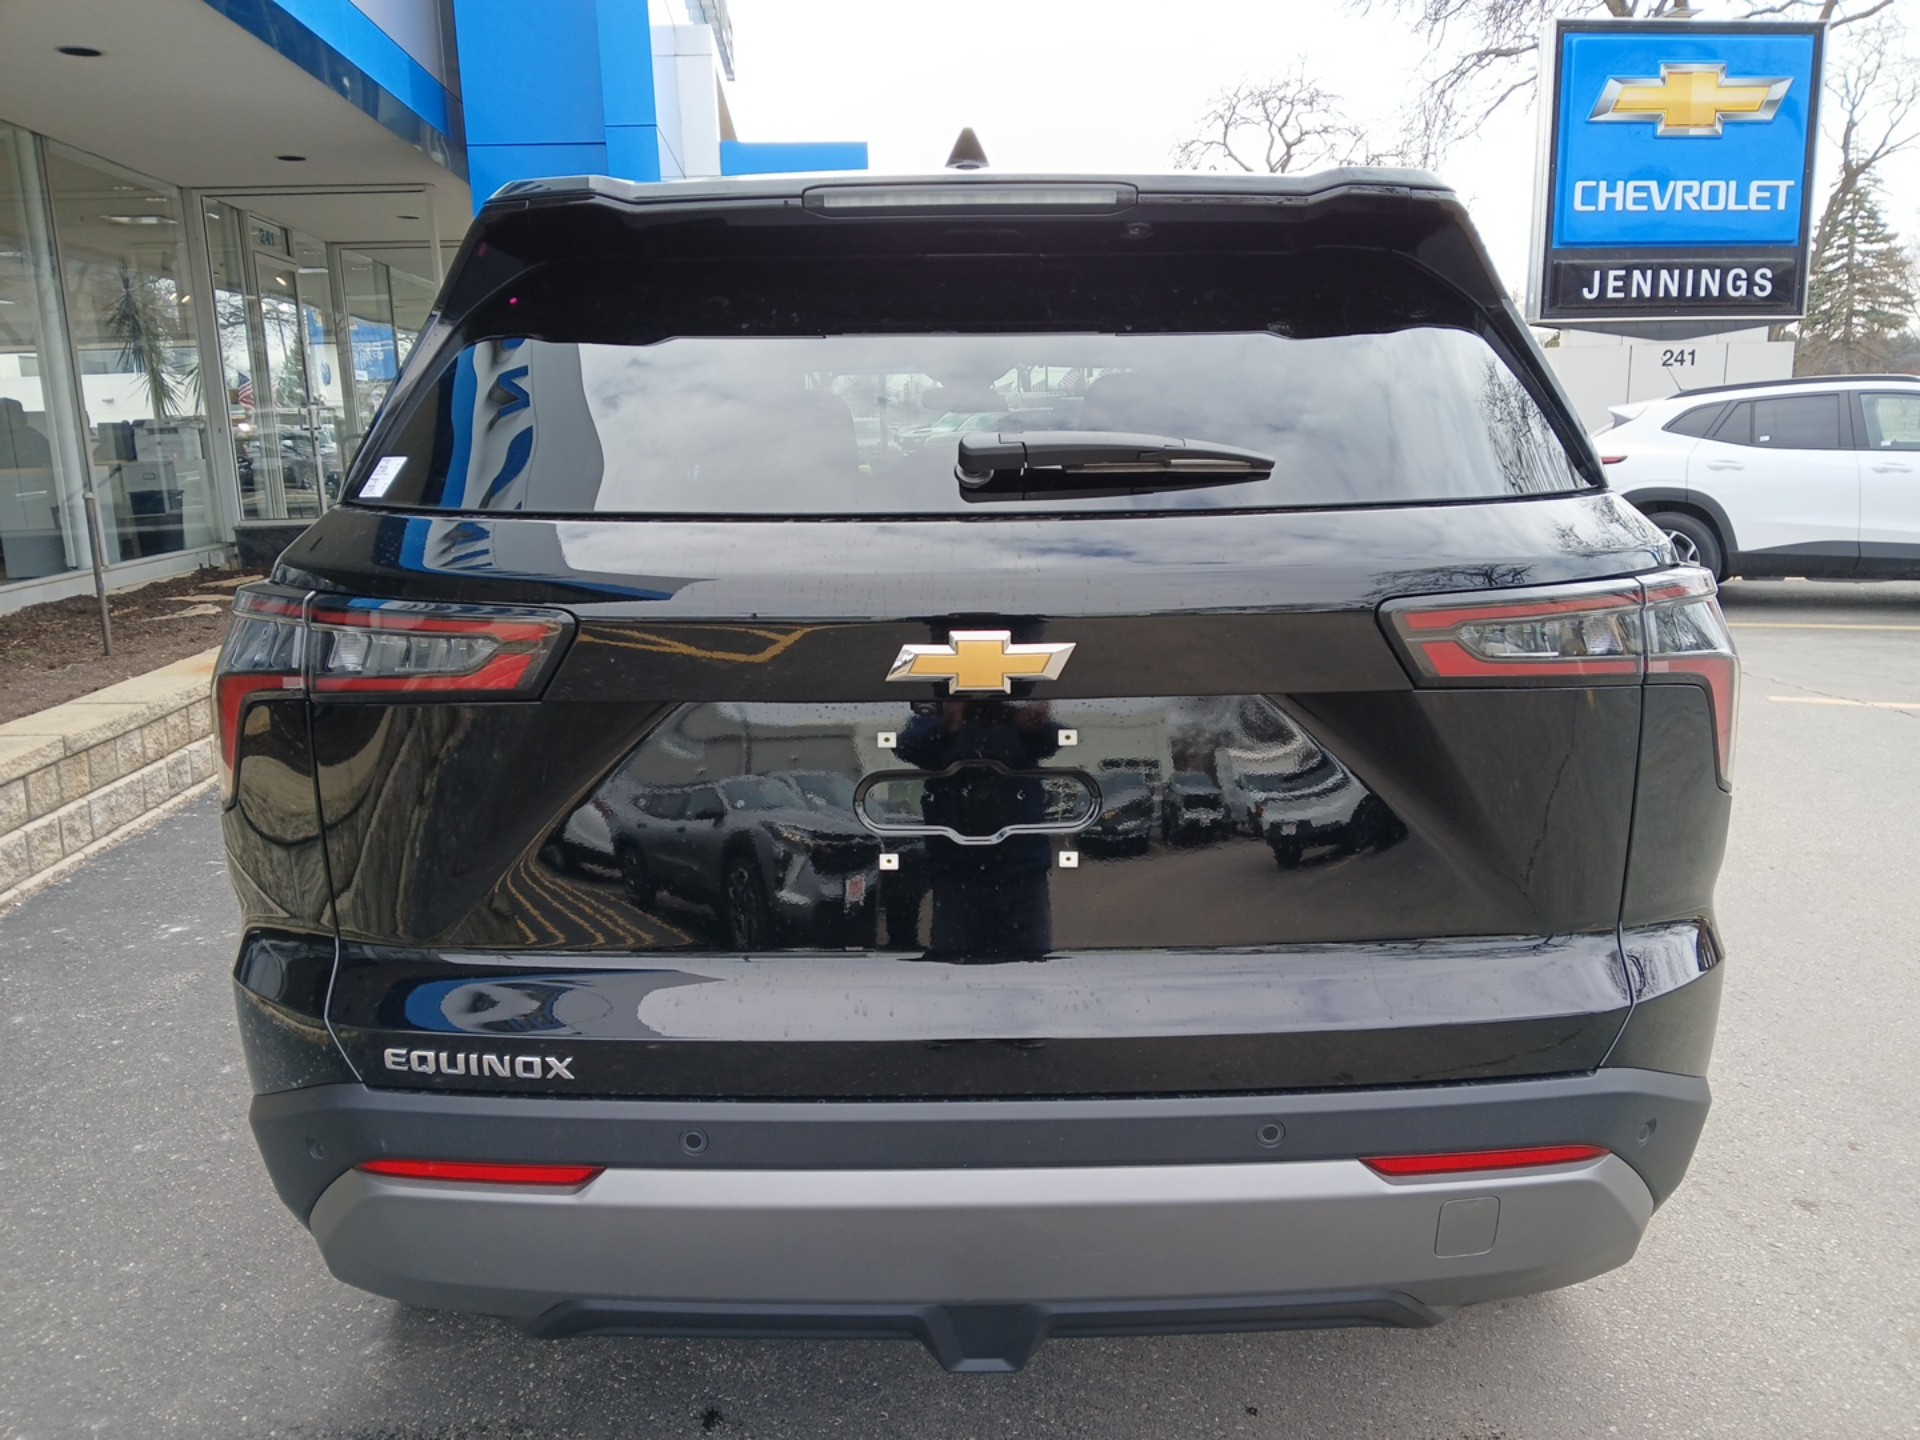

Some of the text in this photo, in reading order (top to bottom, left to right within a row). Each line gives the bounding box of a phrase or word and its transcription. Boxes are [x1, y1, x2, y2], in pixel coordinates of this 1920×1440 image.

[1573, 179, 1795, 212] CHEVROLET
[1582, 267, 1773, 300] JENNINGS
[1661, 349, 1696, 367] 241
[383, 1047, 576, 1080] EQUINOX
